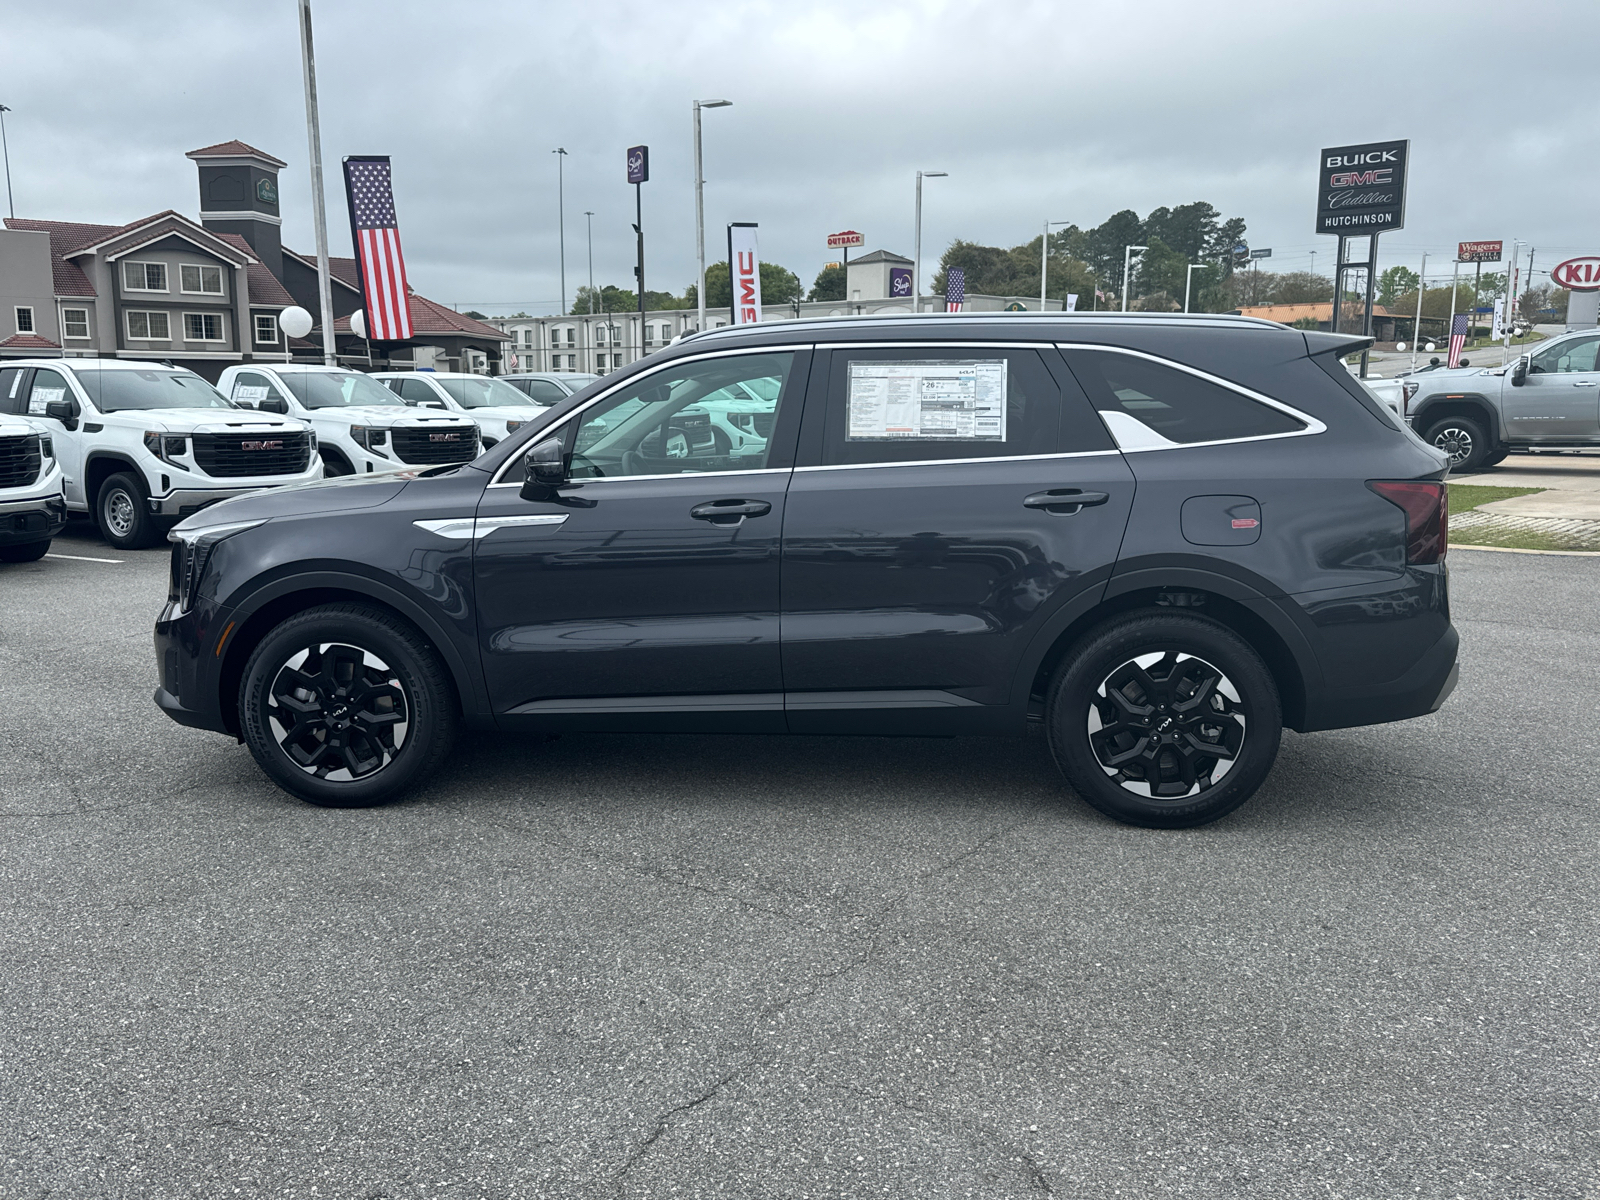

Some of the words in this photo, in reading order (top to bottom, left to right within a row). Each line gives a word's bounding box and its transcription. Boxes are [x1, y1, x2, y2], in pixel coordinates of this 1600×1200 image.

[1326, 149, 1399, 168] BUICK
[1330, 168, 1393, 188] GMC
[1327, 189, 1393, 209] Cadillac
[1325, 213, 1392, 227] HUTCHINSON
[827, 235, 861, 246] OUTBACK
[1461, 243, 1500, 253] Wagers
[894, 277, 910, 293] Sleep
[428, 433, 460, 442] GMC
[241, 440, 283, 451] GMC
